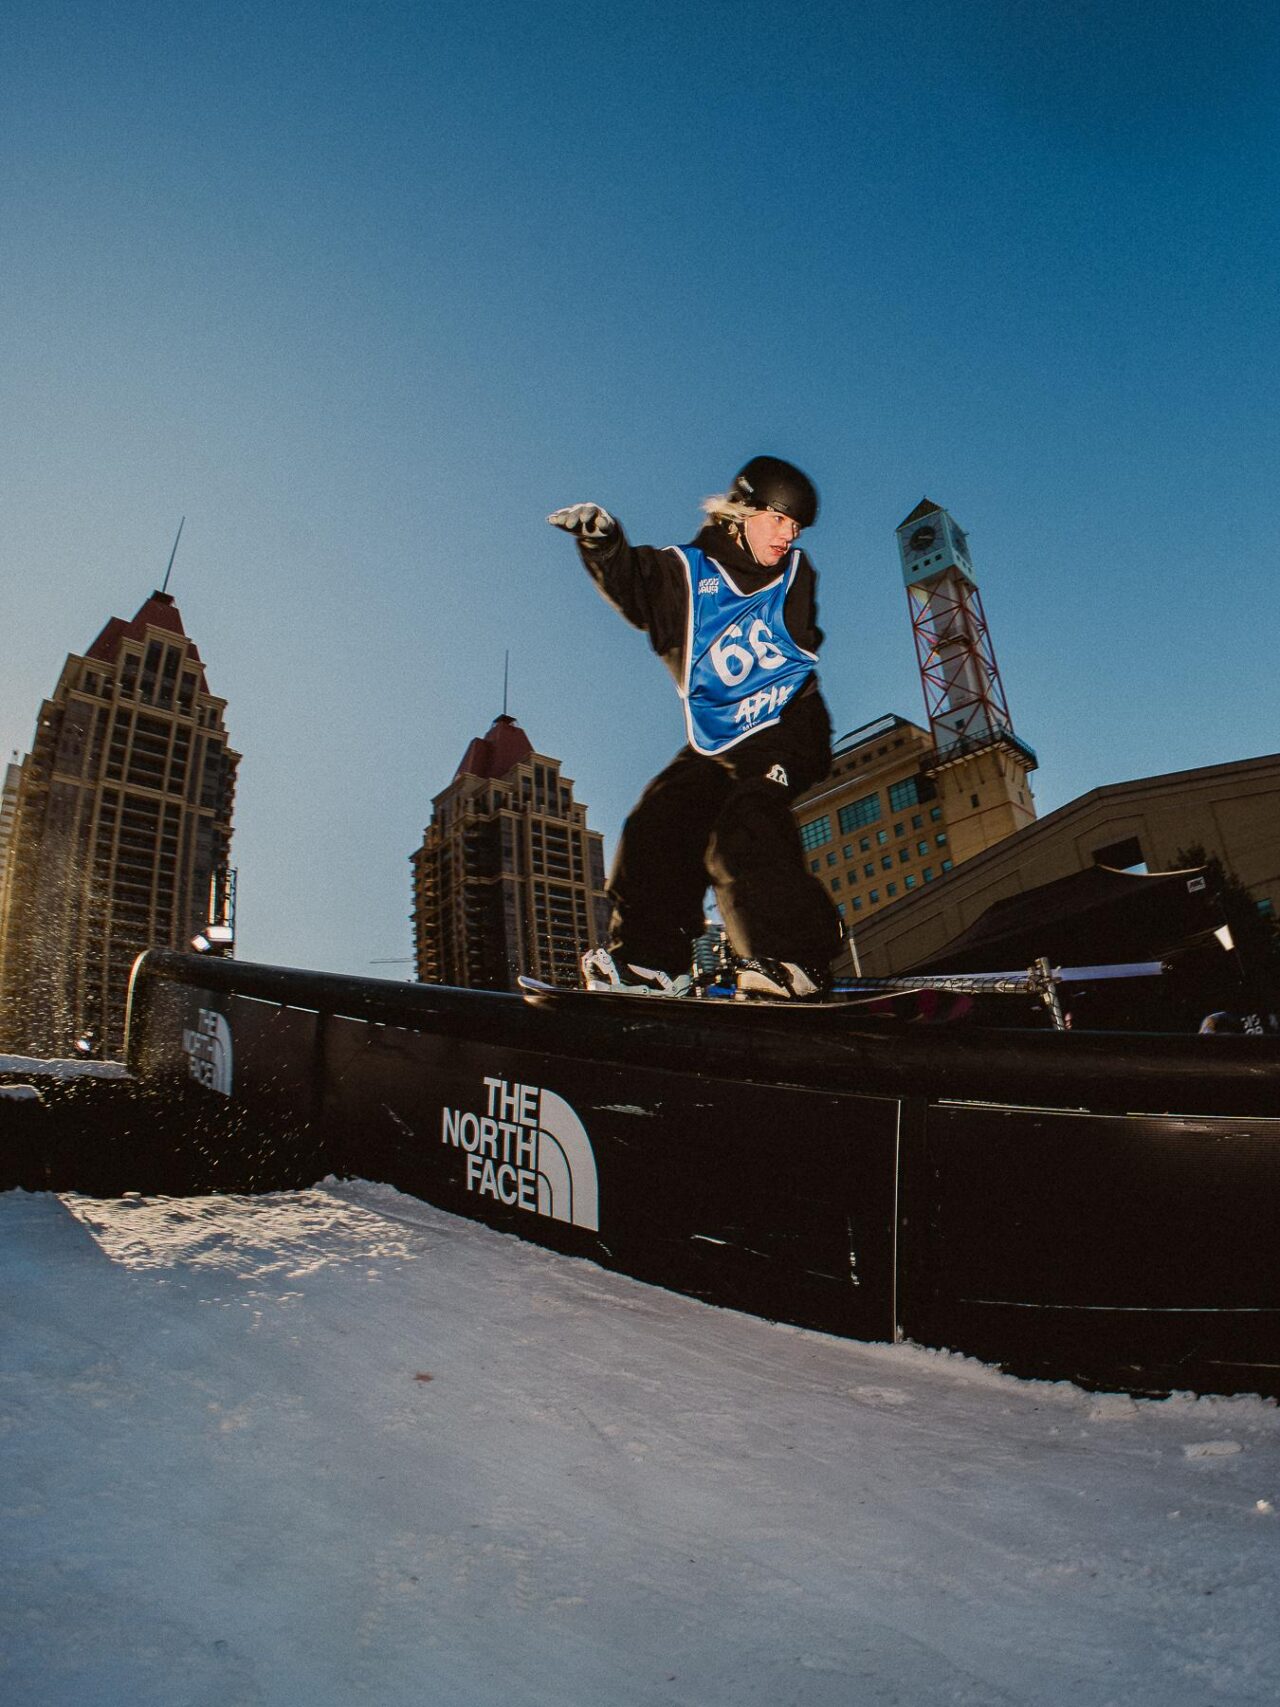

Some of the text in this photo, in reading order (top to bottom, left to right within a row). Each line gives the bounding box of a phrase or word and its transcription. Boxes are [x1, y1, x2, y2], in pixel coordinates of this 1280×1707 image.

[710, 618, 788, 687] 66
[483, 1076, 539, 1128] THE
[442, 1107, 538, 1170] NORTH
[466, 1153, 537, 1213] FACE
